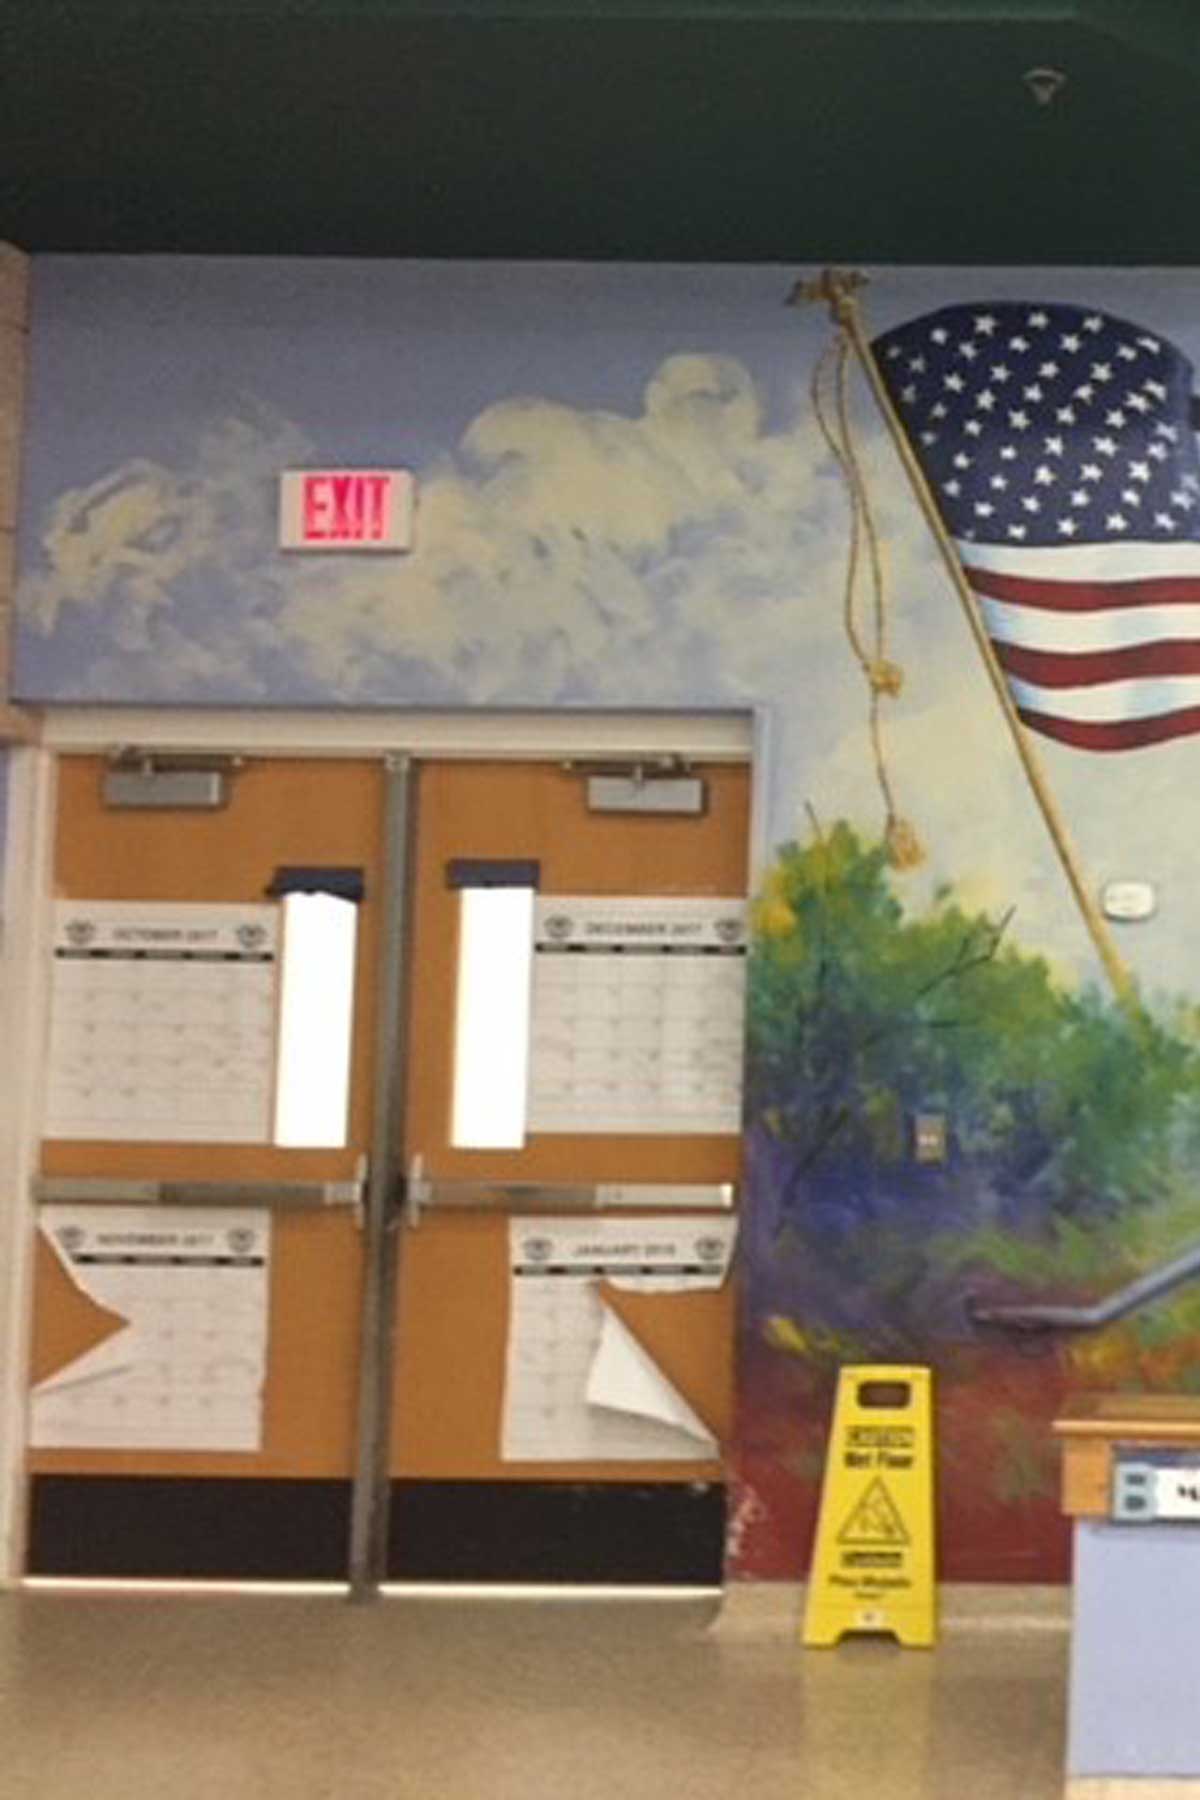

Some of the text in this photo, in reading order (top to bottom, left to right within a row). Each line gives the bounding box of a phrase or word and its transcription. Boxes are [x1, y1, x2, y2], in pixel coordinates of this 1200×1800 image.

[304, 476, 390, 540] EXIT
[112, 927, 182, 942] OCTOBER
[586, 922, 666, 936] DECEMBER
[97, 1232, 178, 1247] NOVEMBER
[572, 1243, 639, 1257] JANUARY
